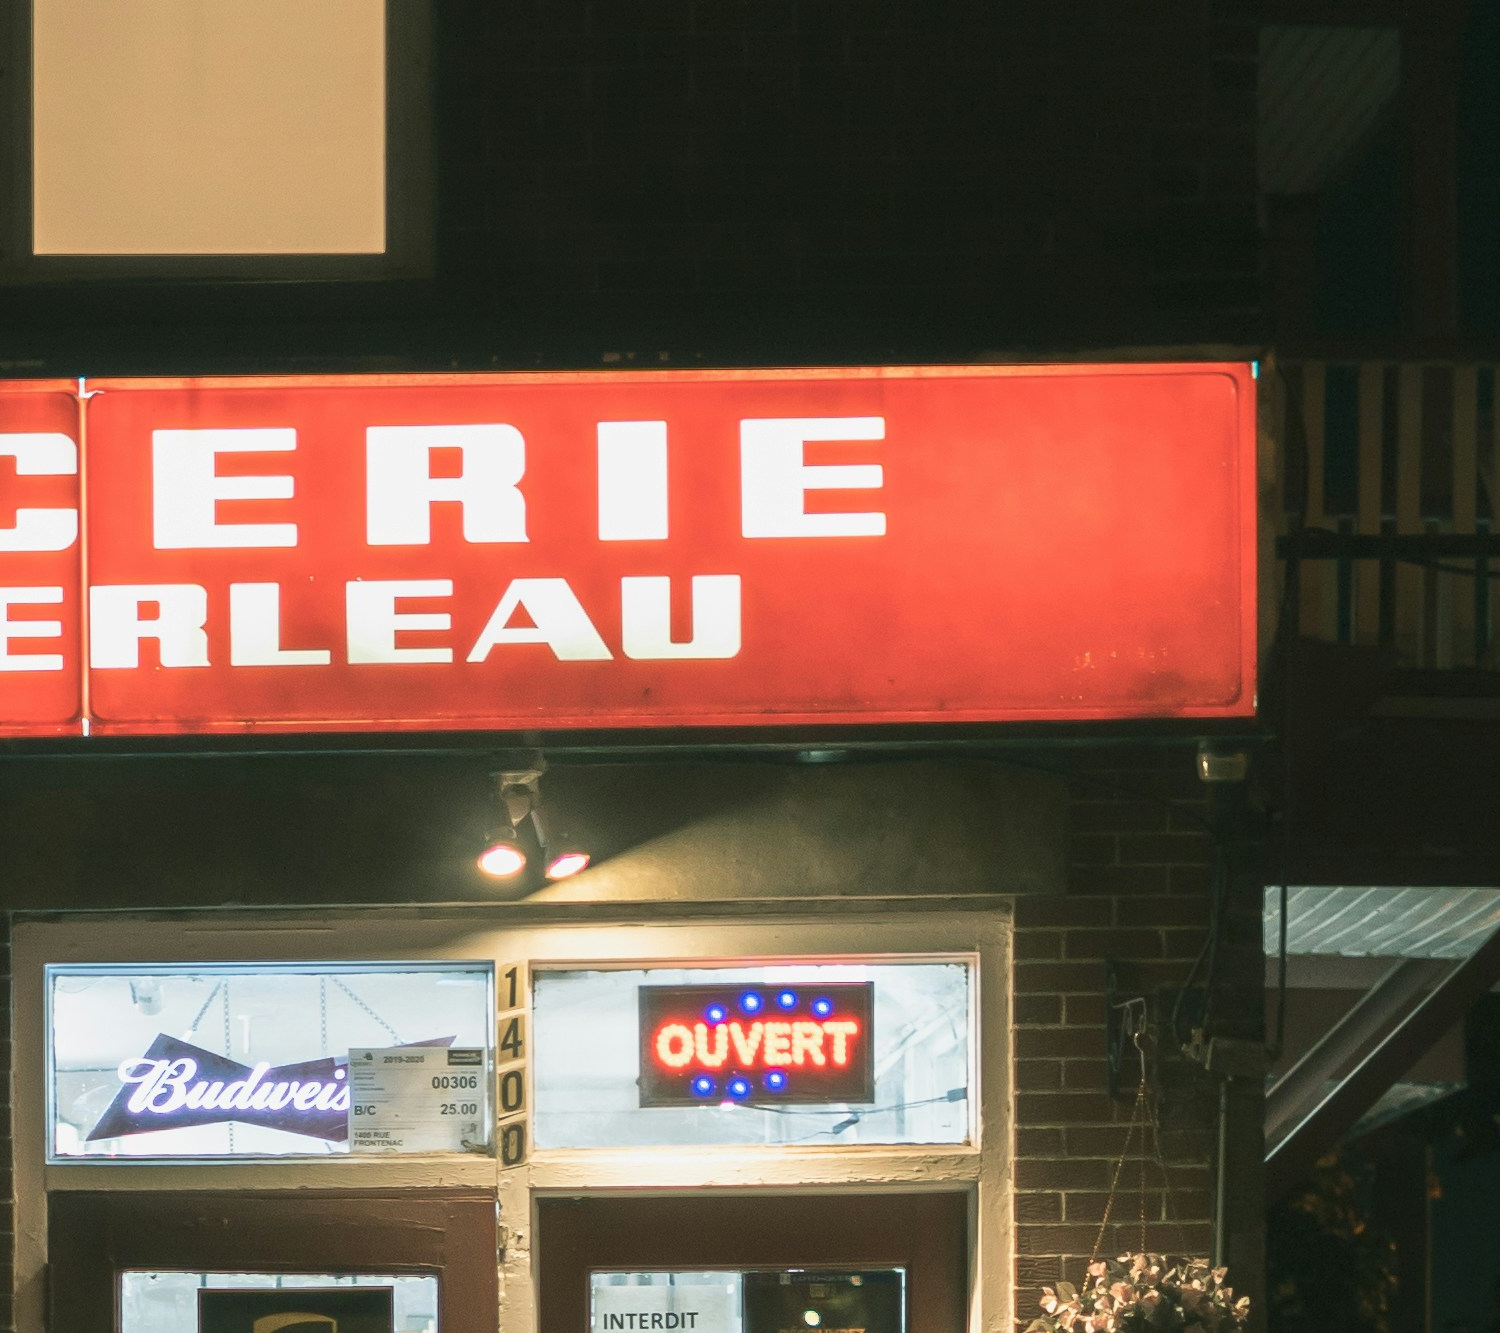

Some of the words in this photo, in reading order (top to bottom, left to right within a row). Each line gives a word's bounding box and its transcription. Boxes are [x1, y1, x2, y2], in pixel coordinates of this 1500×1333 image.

[655, 1021, 858, 1068] OUVERT
[117, 1057, 350, 1114] Budweis
[431, 1076, 477, 1089] 00306
[353, 1105, 376, 1116] B/C
[440, 1103, 477, 1115] 25.00
[603, 1312, 699, 1330] INTERDIT
